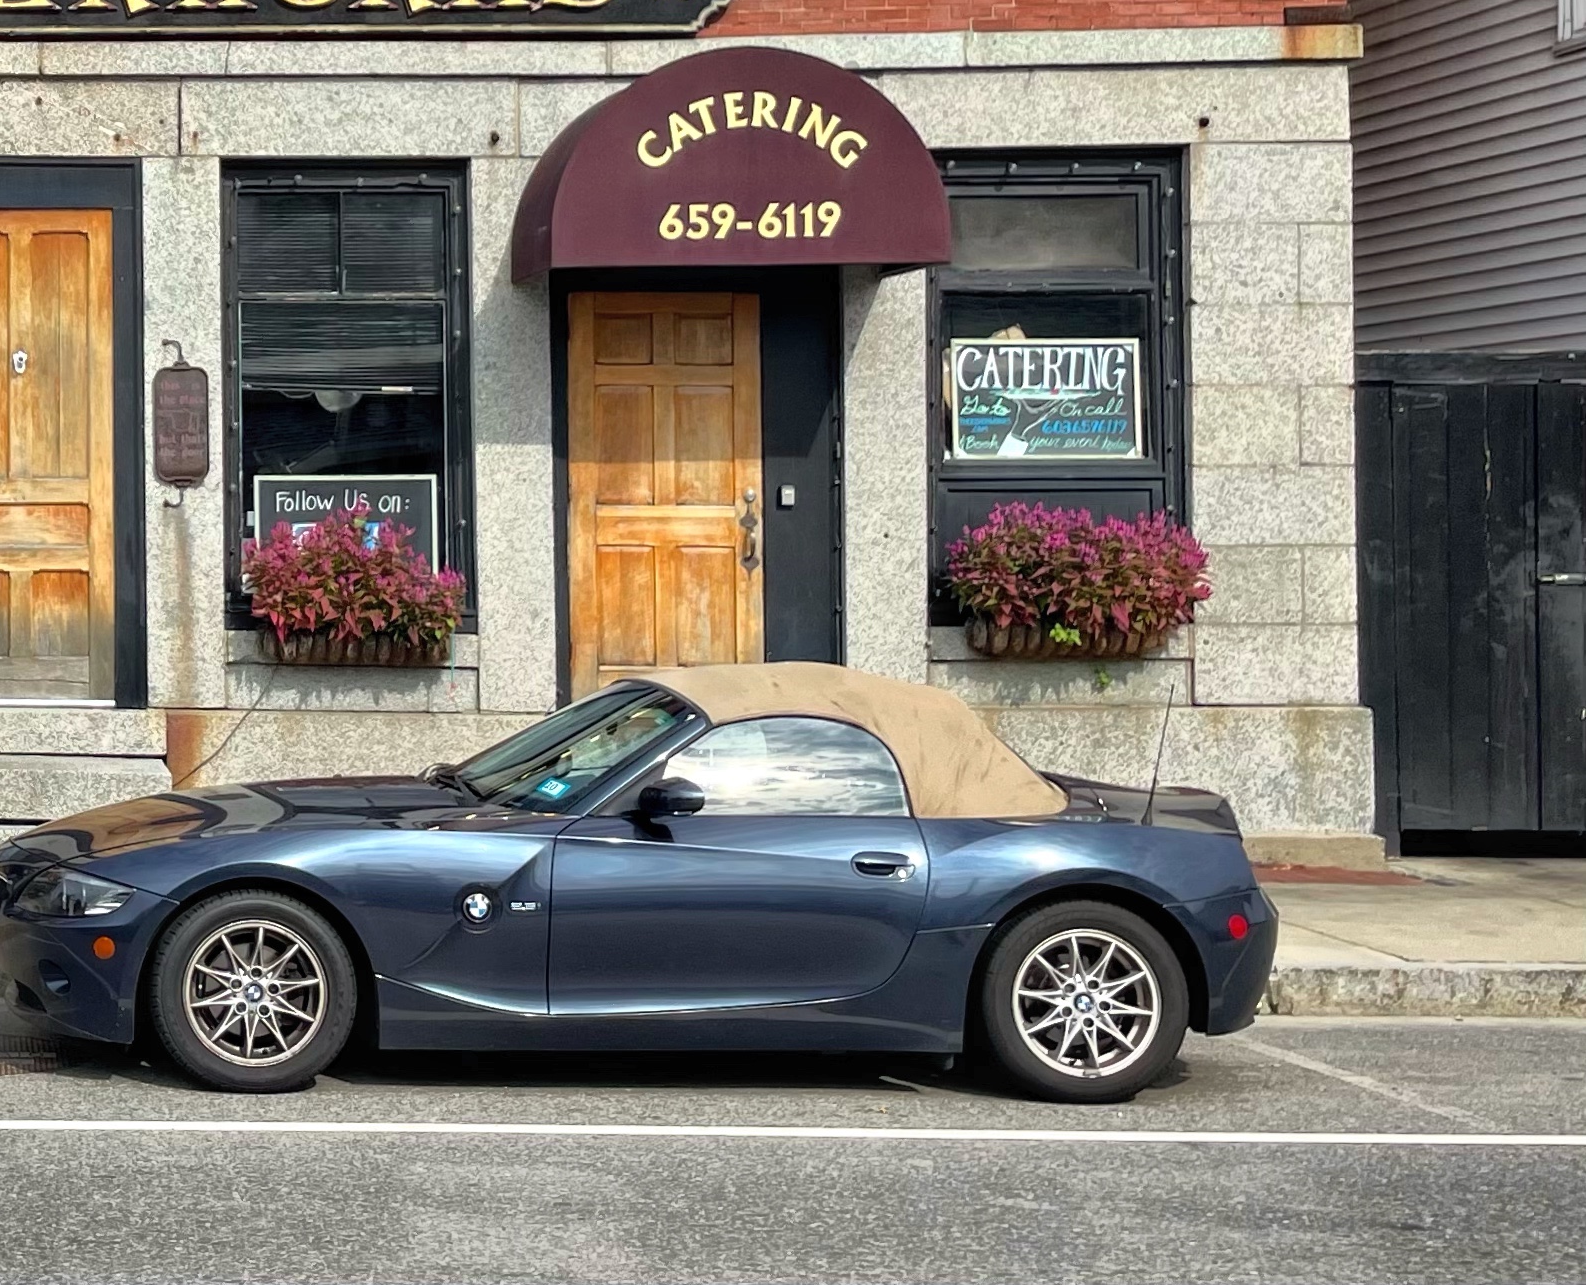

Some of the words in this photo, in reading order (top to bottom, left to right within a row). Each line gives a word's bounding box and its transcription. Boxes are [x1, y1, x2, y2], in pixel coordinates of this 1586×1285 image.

[636, 90, 869, 169] CATERING
[657, 200, 842, 241] 659-6119
[957, 346, 1127, 396] CATERING
[1085, 396, 1128, 417] call
[1028, 437, 1060, 454] your
[1062, 435, 1101, 450] event
[275, 490, 335, 512] Follow
[344, 489, 370, 511] Us
[377, 493, 411, 513] on:
